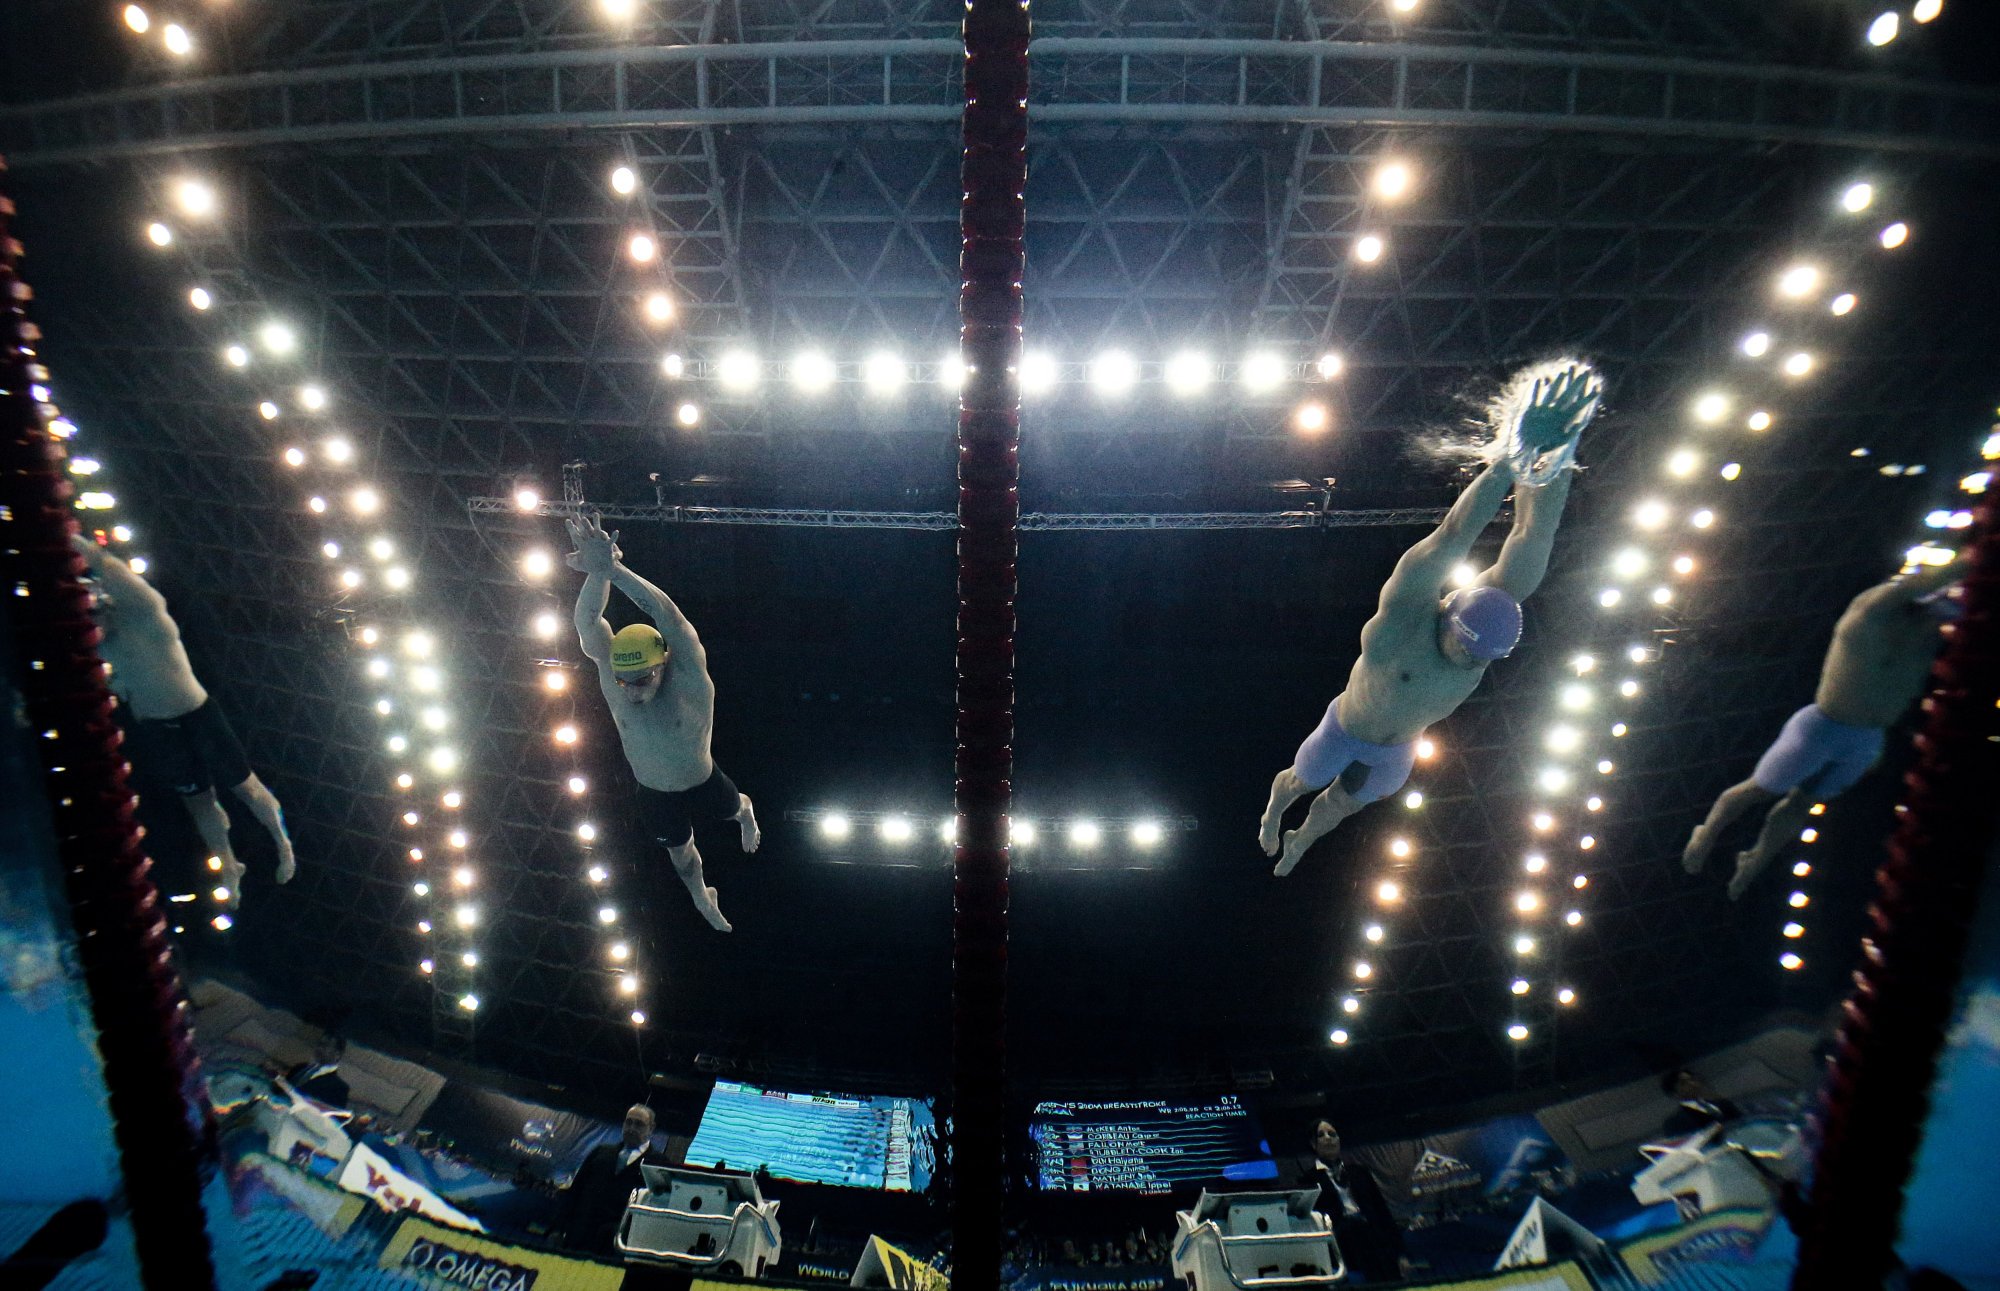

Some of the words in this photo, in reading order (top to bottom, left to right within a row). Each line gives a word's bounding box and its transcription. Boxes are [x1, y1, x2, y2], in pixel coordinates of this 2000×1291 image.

[613, 651, 642, 661] arena
[1221, 1096, 1237, 1105] 0.7
[1185, 1111, 1224, 1119] REACTION
[434, 1253, 526, 1291] OMEGA
[798, 1263, 849, 1280] WORLD
